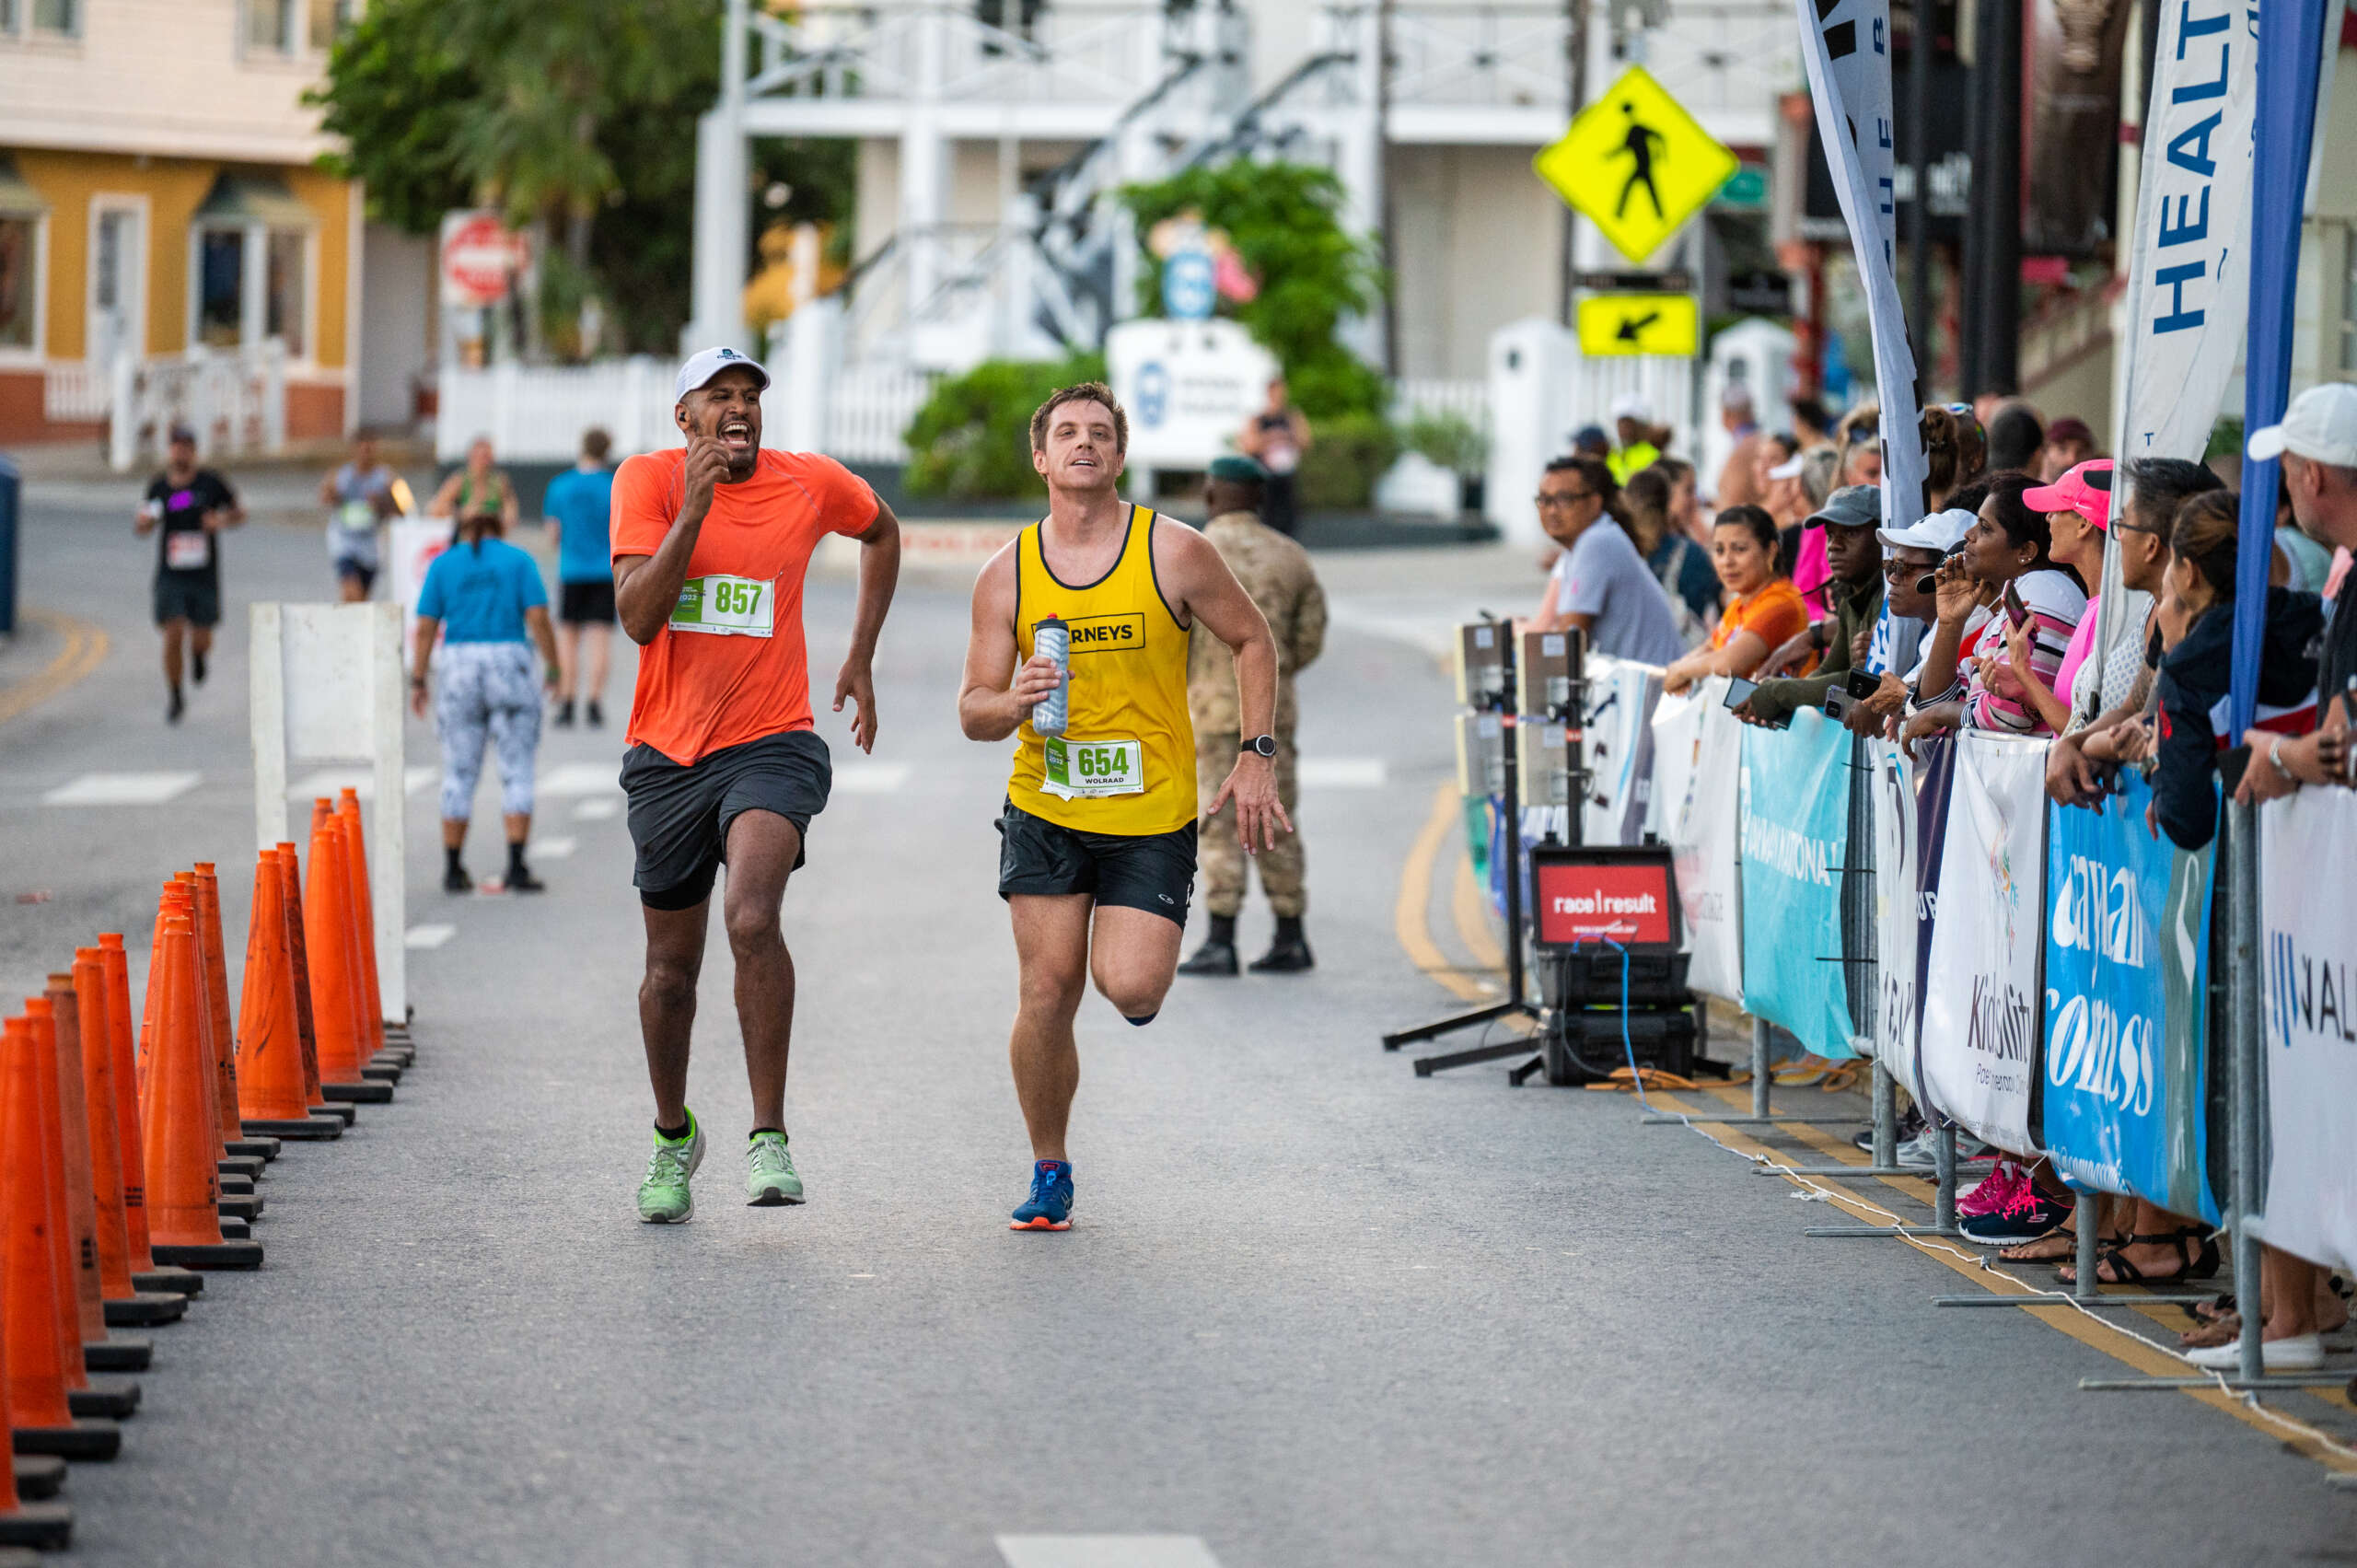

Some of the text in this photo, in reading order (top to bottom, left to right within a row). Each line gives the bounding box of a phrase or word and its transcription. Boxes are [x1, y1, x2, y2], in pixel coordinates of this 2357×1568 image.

[715, 581, 763, 615] 857
[1068, 624, 1133, 644] RNEYS
[1078, 747, 1129, 776] 654
